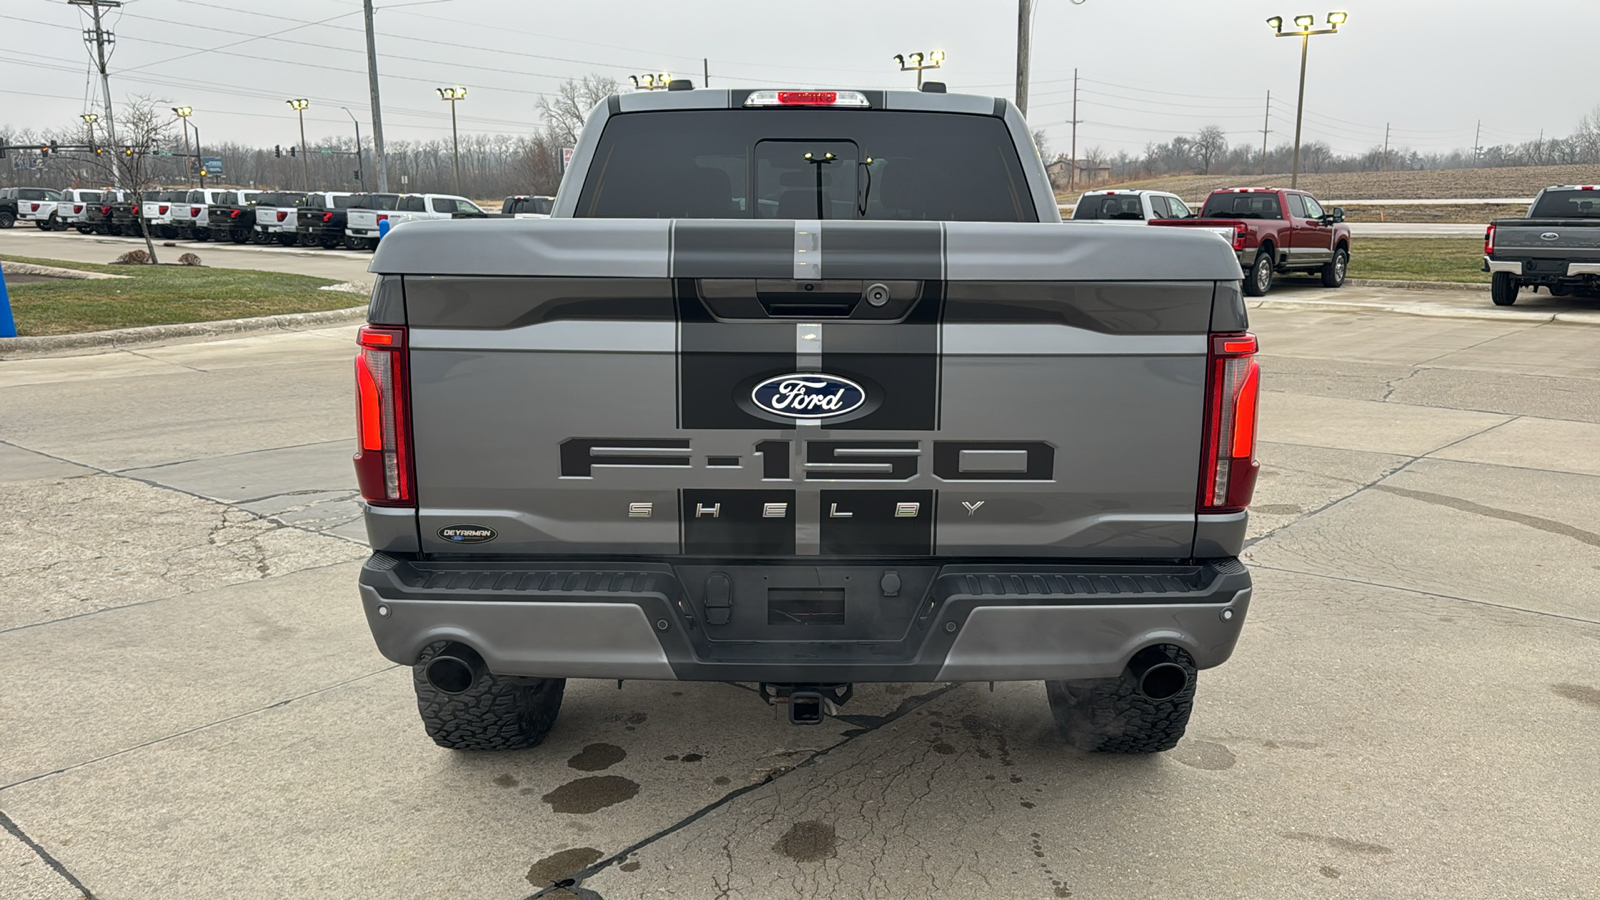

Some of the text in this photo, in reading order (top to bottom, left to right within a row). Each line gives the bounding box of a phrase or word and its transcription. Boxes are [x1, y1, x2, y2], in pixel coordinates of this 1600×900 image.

[771, 379, 844, 410] Ford
[558, 437, 1057, 483] F-150
[627, 500, 986, 519] SHELBY
